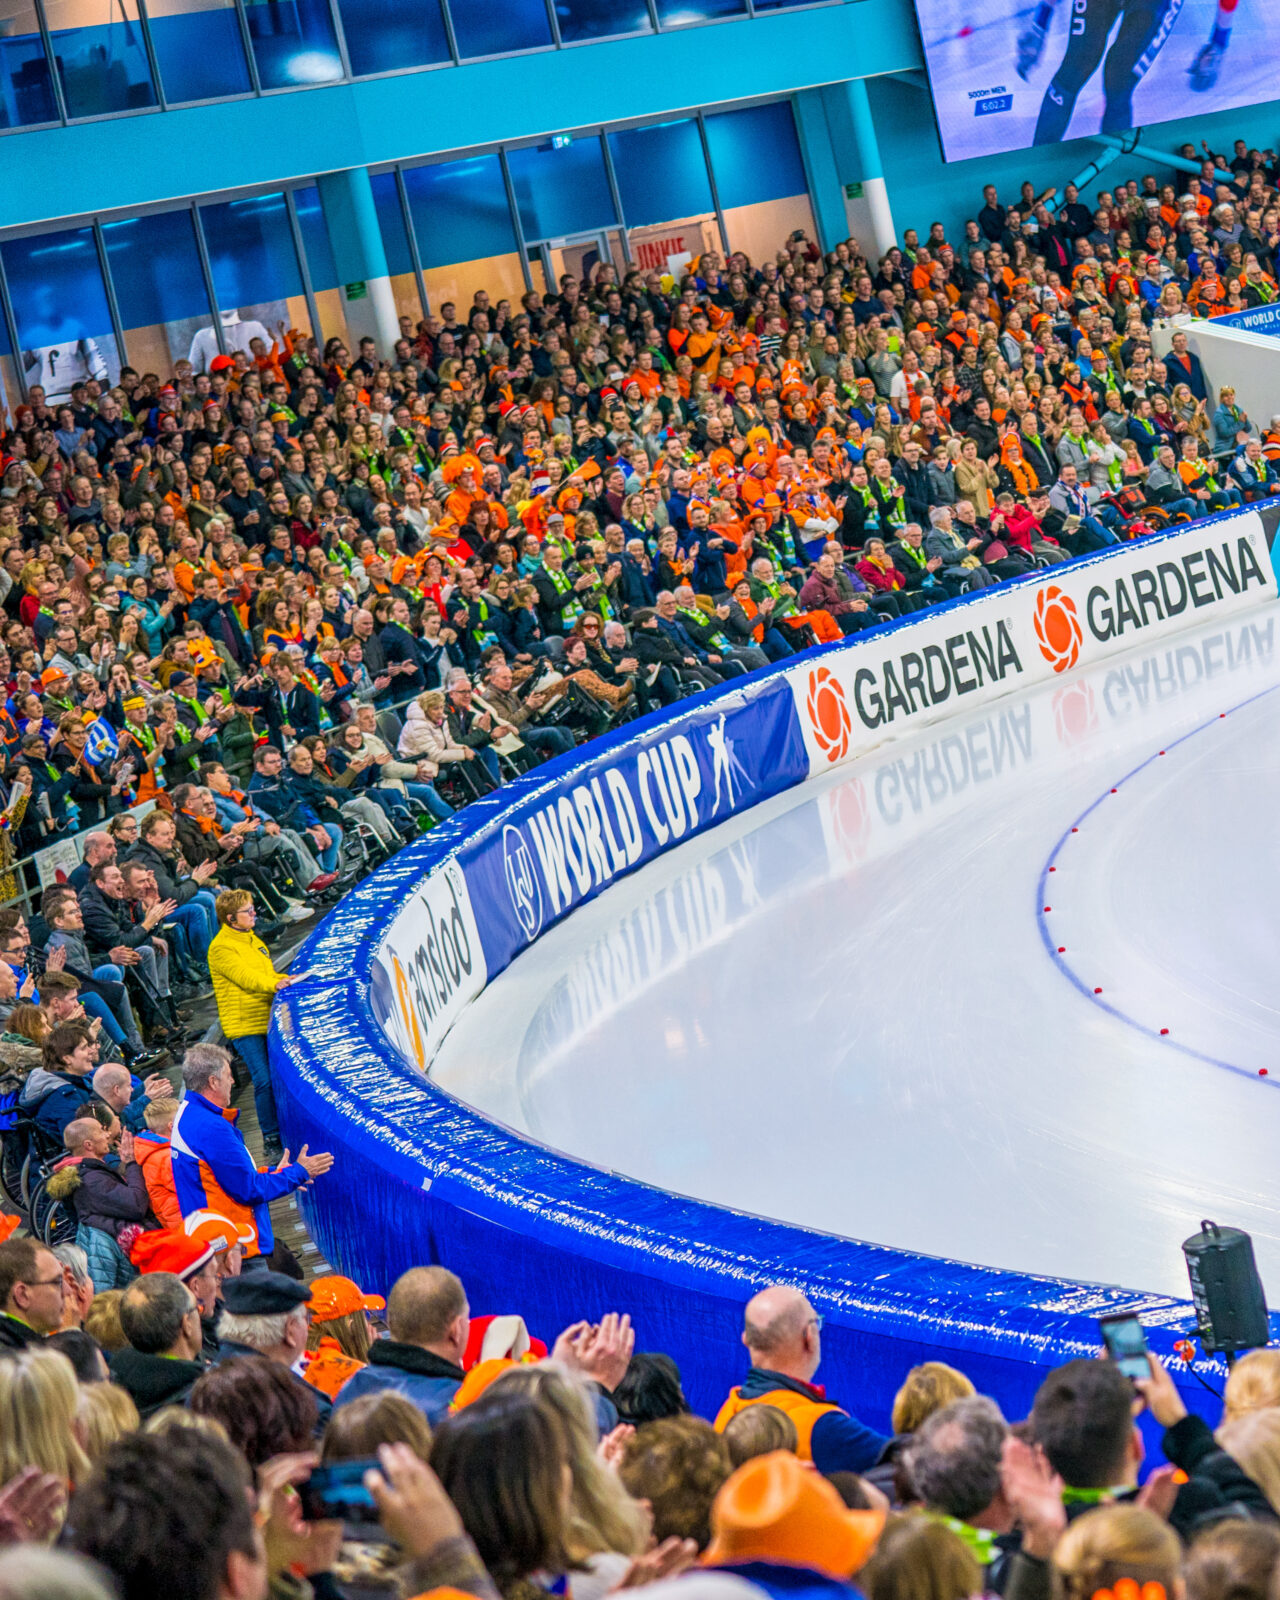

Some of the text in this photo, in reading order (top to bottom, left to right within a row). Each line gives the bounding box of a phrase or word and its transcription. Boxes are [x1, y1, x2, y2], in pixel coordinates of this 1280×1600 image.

[1243, 311, 1274, 328] WORLD
[1087, 537, 1267, 642] GARDENA
[853, 619, 1023, 729] GARDENA
[528, 734, 701, 915] WORLD CUP
